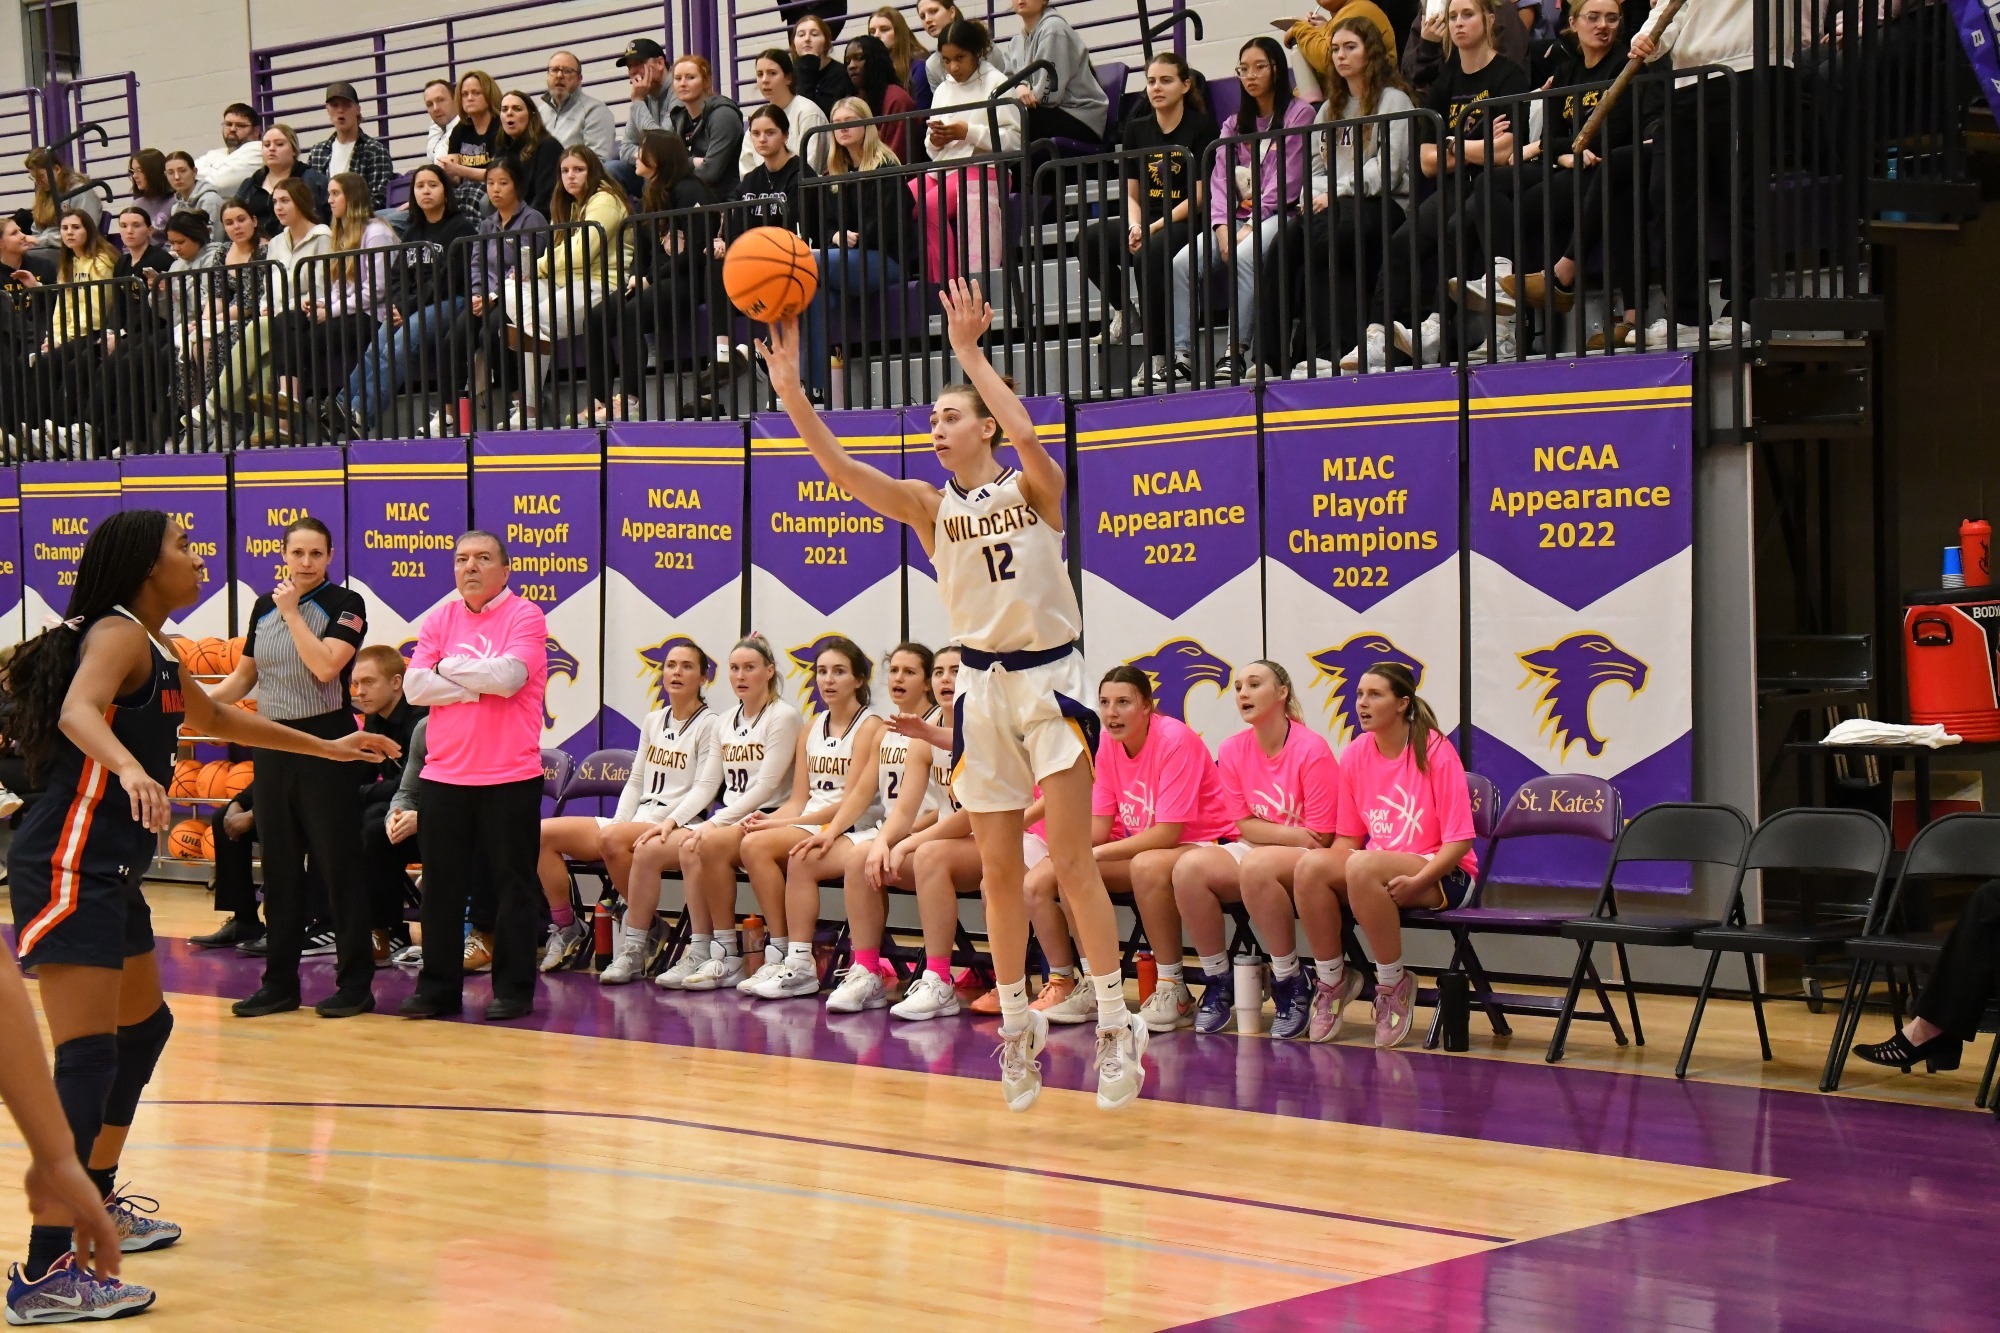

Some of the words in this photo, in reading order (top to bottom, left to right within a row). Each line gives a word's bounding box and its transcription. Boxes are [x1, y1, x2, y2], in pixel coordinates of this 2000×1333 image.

[1322, 455, 1395, 482] MIAC
[1534, 443, 1620, 472] NCAA
[1132, 469, 1202, 496] NCAA
[513, 494, 561, 515] MIAC
[648, 488, 702, 510] NCAA
[1312, 489, 1408, 522] Playoff
[1489, 485, 1671, 518] Appearance
[385, 502, 430, 522] MIAC
[770, 511, 885, 538] Champions
[943, 504, 1038, 543] WILDCATS
[1097, 504, 1246, 538] Appearance
[52, 517, 89, 535] MIAC
[507, 522, 570, 548] Playoff
[621, 517, 732, 543] Appearance
[1539, 521, 1616, 548] 2022
[34, 542, 86, 565] Champi
[364, 529, 455, 554] Champions
[1144, 542, 1197, 565] 2022
[1288, 526, 1439, 557] Champions
[508, 552, 589, 577] ampions
[654, 551, 695, 570] 2021
[804, 546, 848, 565] 2021
[982, 542, 1016, 583] 12
[274, 564, 292, 580] 20
[391, 560, 426, 578] 2021
[1333, 566, 1389, 588] 2022
[519, 584, 557, 602] 2021
[578, 761, 596, 781] St.
[887, 770, 905, 800] 2
[1516, 787, 1542, 812] St.
[1549, 789, 1605, 813] Kate's
